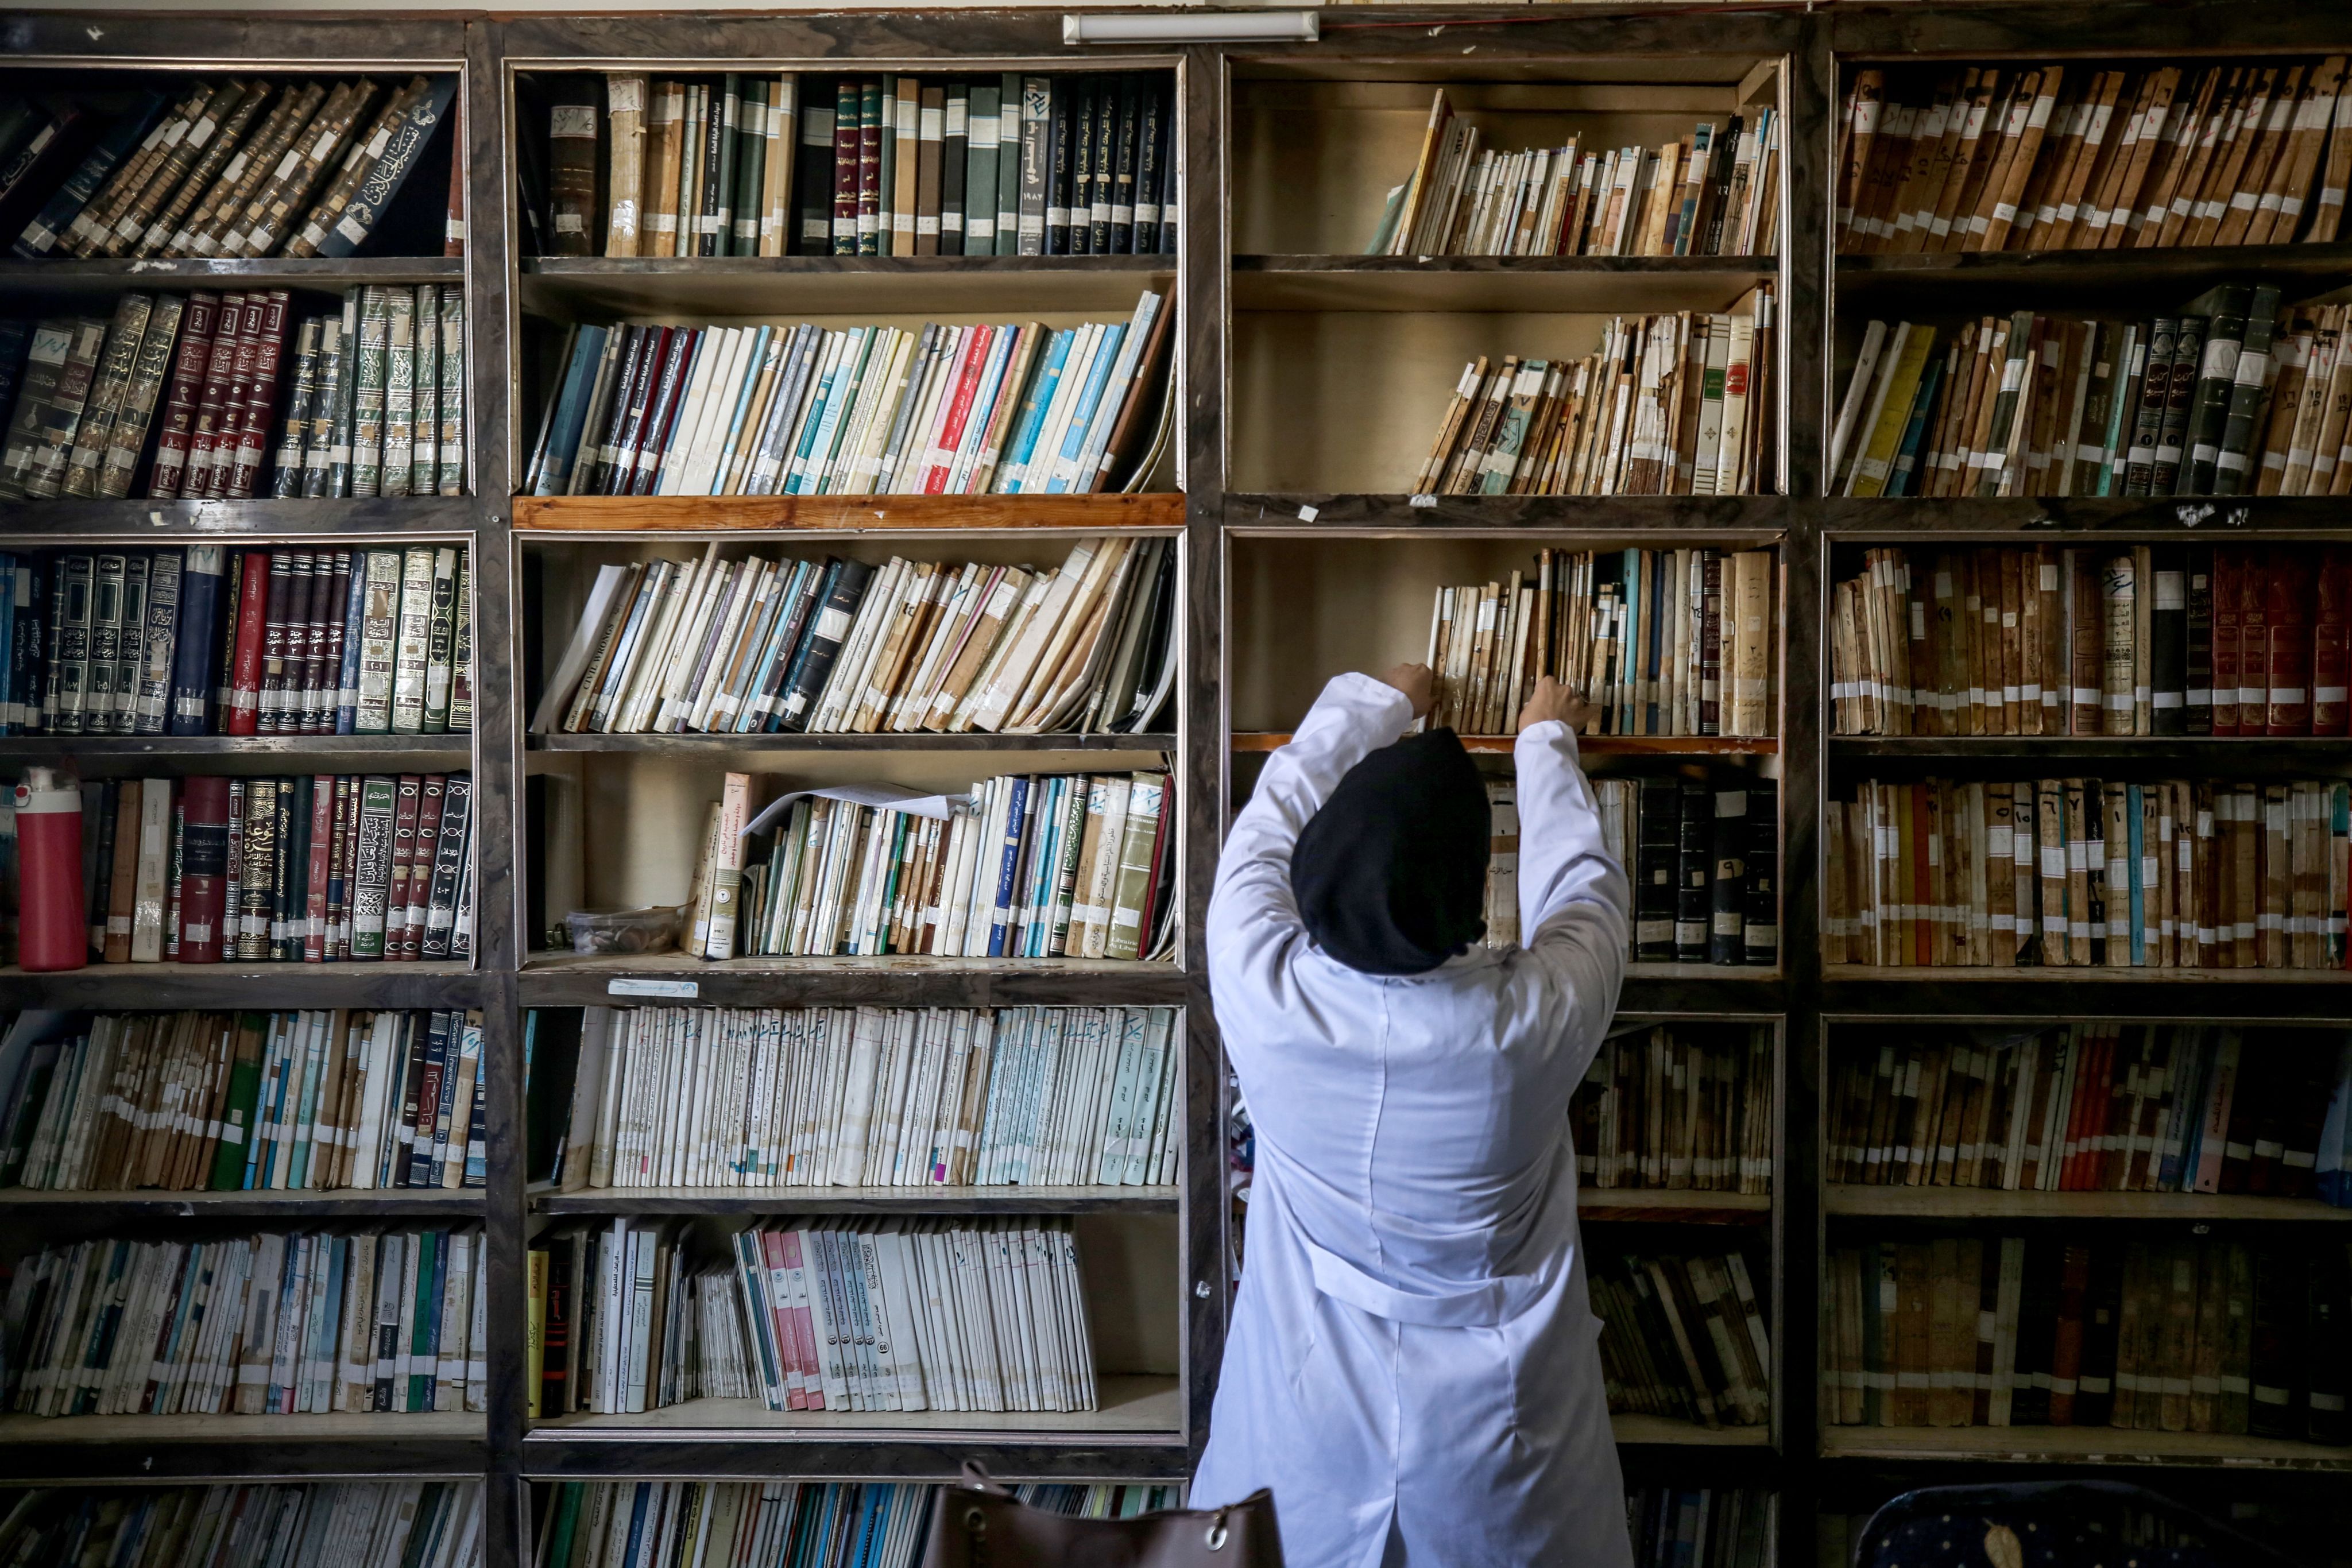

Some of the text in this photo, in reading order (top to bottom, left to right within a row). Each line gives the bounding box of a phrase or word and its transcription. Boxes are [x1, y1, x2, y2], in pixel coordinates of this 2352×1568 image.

[359, 123, 424, 207] تفسير الجلالين
[581, 622, 616, 691] CIVIL WRONGS
[1127, 815, 1158, 826] Dictionary
[1112, 937, 1138, 946] Librairie
[417, 1070, 442, 1125] المراجعات
